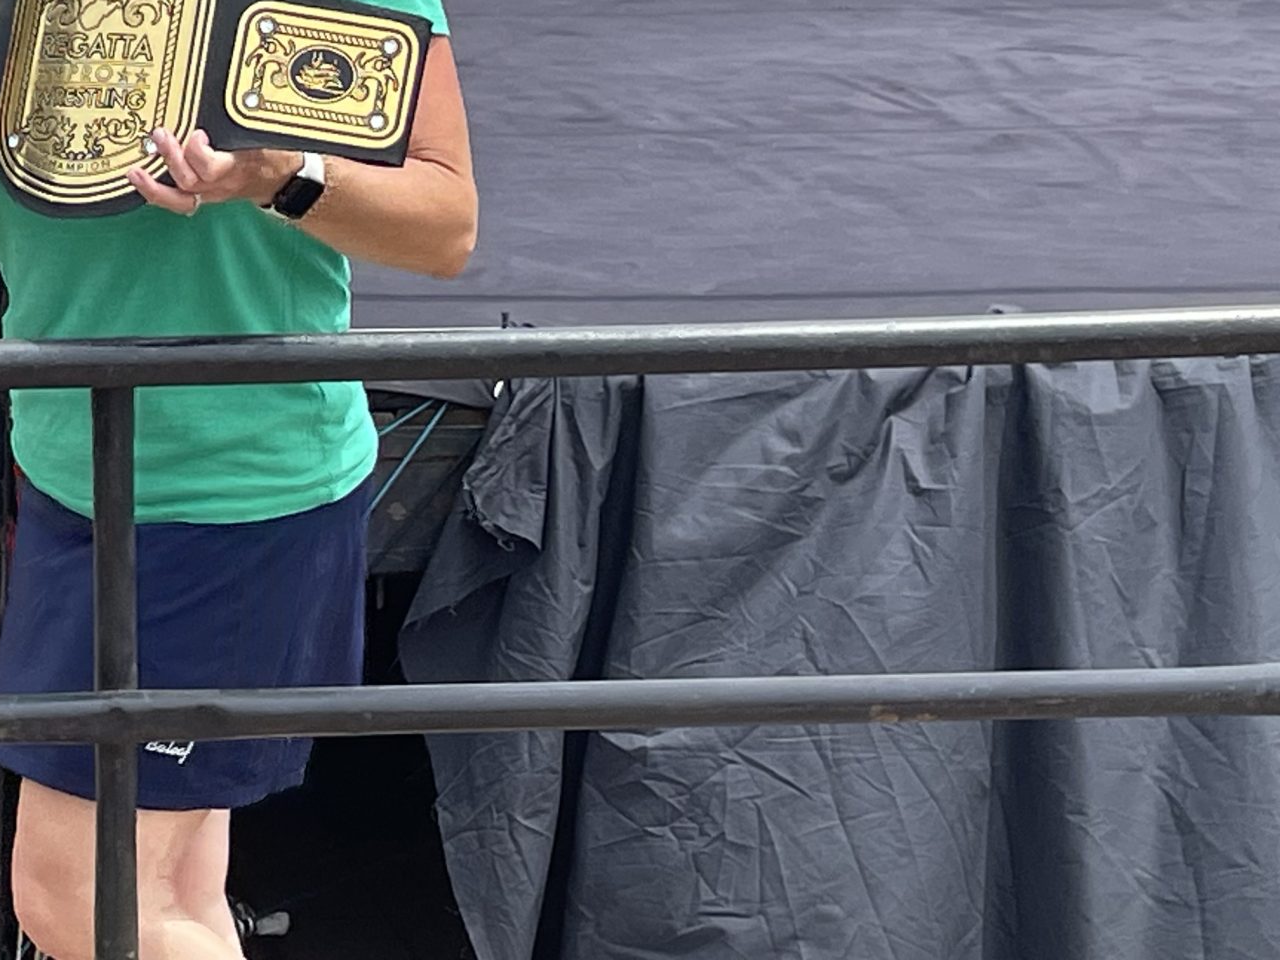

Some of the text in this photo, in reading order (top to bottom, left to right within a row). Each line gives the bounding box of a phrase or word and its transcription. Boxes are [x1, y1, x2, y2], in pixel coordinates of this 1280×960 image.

[42, 32, 154, 61] REGATTA
[65, 63, 114, 83] PRO
[36, 87, 147, 110] WRESTLING
